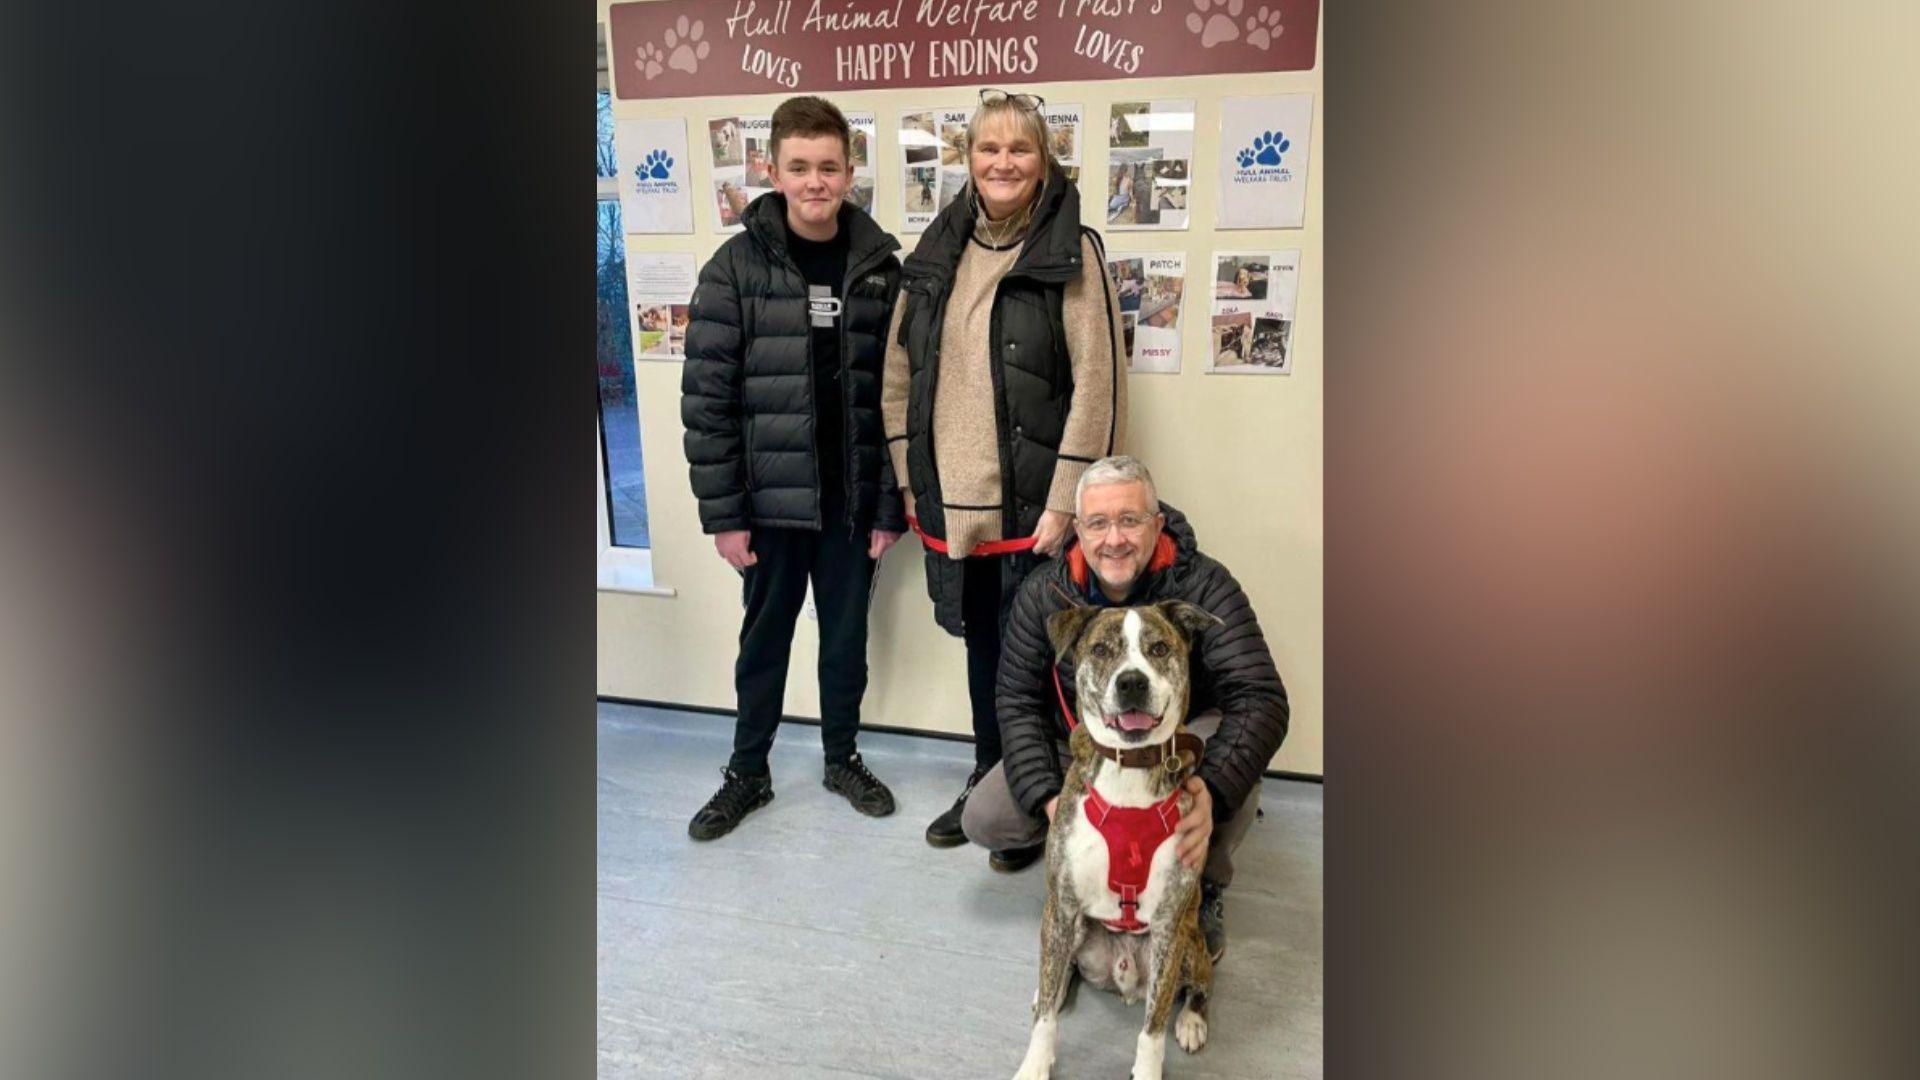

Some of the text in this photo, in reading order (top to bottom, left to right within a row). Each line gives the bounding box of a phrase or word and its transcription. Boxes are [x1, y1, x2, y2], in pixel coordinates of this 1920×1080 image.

[726, 0, 1163, 39] Hull Animal Welfare rusts
[835, 35, 1039, 83] HAPPY ENDINGS
[1073, 24, 1145, 74] LOVES
[741, 43, 802, 89] LOVES
[943, 112, 966, 123] SAM
[1269, 175, 1293, 183] TRUST
[1149, 259, 1182, 270] PATCH
[1141, 347, 1172, 357] MISSY
